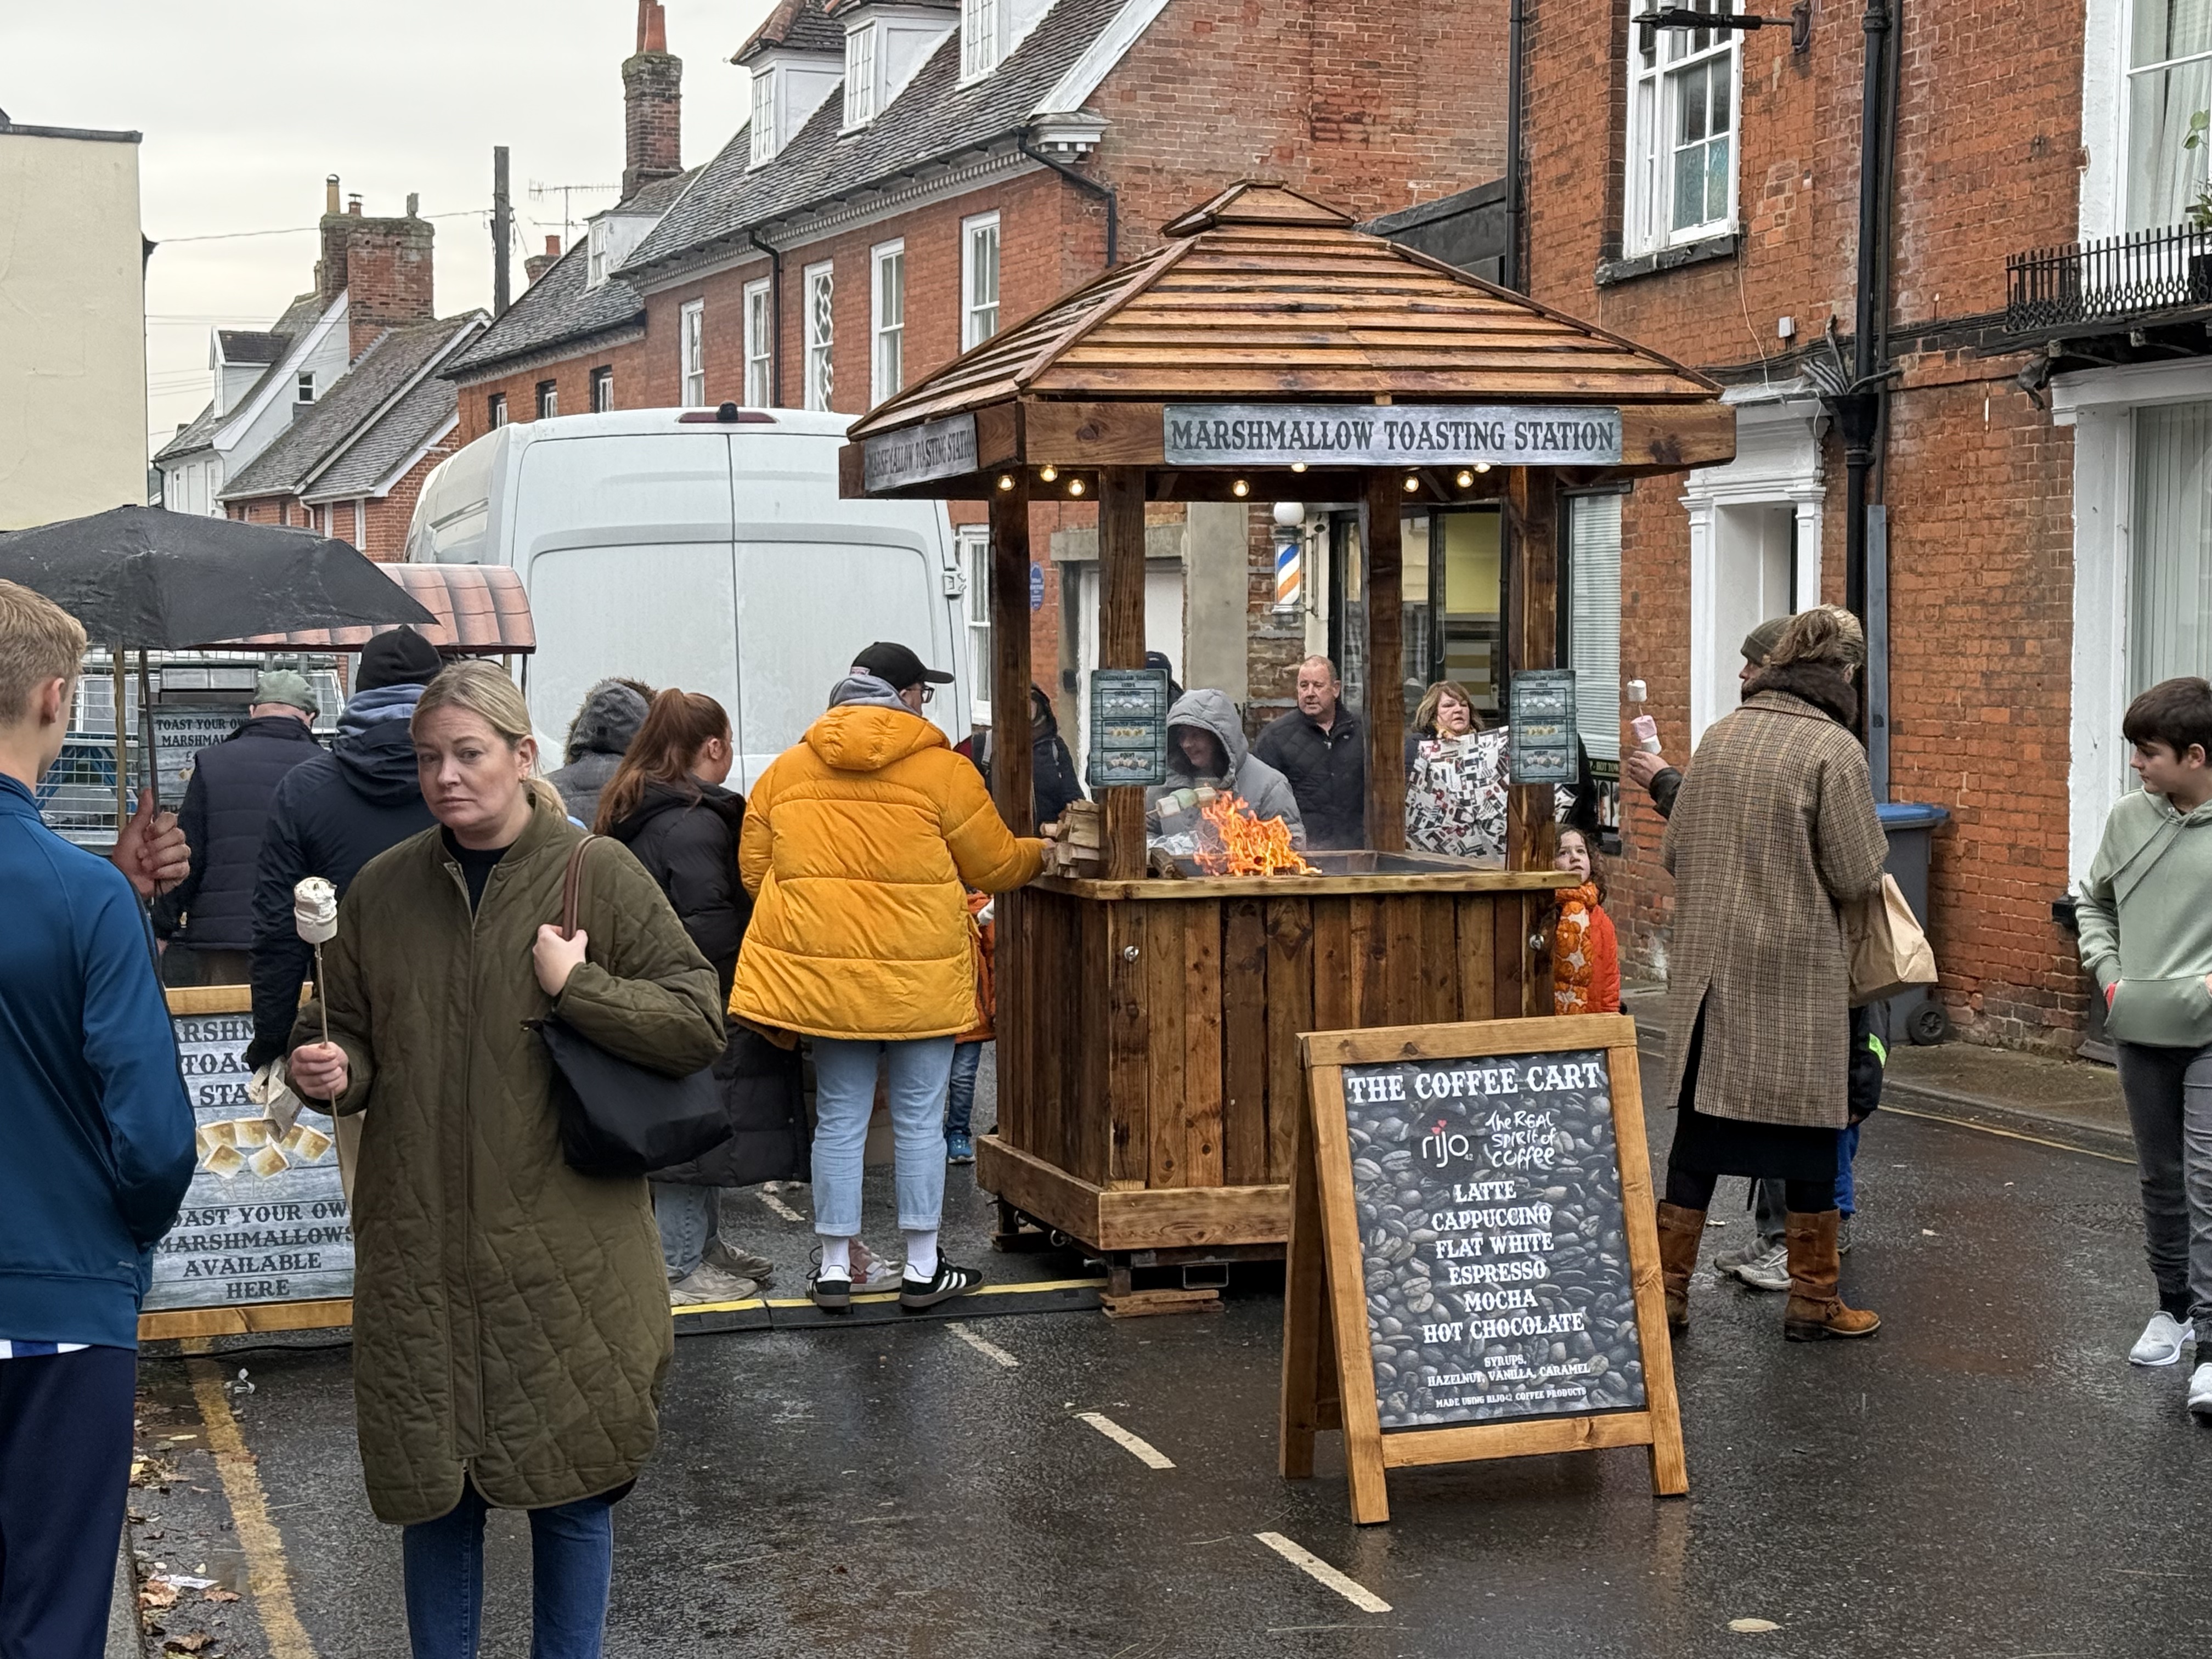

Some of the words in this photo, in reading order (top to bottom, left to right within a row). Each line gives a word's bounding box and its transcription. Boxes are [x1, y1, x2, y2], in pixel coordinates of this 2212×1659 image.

[1171, 420, 1374, 450] MARSHMALLOW
[1384, 421, 1505, 450] TOASTING
[1515, 421, 1614, 450] STATION
[157, 719, 193, 731] TOAST
[195, 719, 226, 730] YOUR
[1348, 1074, 1406, 1103] THE
[1414, 1068, 1519, 1099] COFFEE
[1526, 1063, 1600, 1092] CART
[1485, 1109, 1511, 1132] The
[1540, 1127, 1558, 1146] of
[1454, 1181, 1517, 1203] LATTE
[239, 1204, 303, 1223] YOUR
[1431, 1205, 1552, 1231] CAPPUCCINO
[1435, 1237, 1483, 1259] FLAT
[1489, 1232, 1554, 1255] WHITE
[183, 1252, 322, 1277] AVAILABLE
[1448, 1261, 1547, 1285] ESPRESSO
[225, 1279, 290, 1299] HERE
[1463, 1289, 1539, 1312] MOCHA
[1422, 1322, 1463, 1344] HOT
[1470, 1312, 1585, 1340] CHOCOLATE
[1487, 1367, 1537, 1381] VANILLA,
[1539, 1363, 1591, 1377] CARAMEL
[1435, 1398, 1460, 1408] MADE
[1461, 1396, 1485, 1406] USING
[1515, 1390, 1545, 1401] COFFEE
[1547, 1386, 1587, 1398] PRODUCTS
